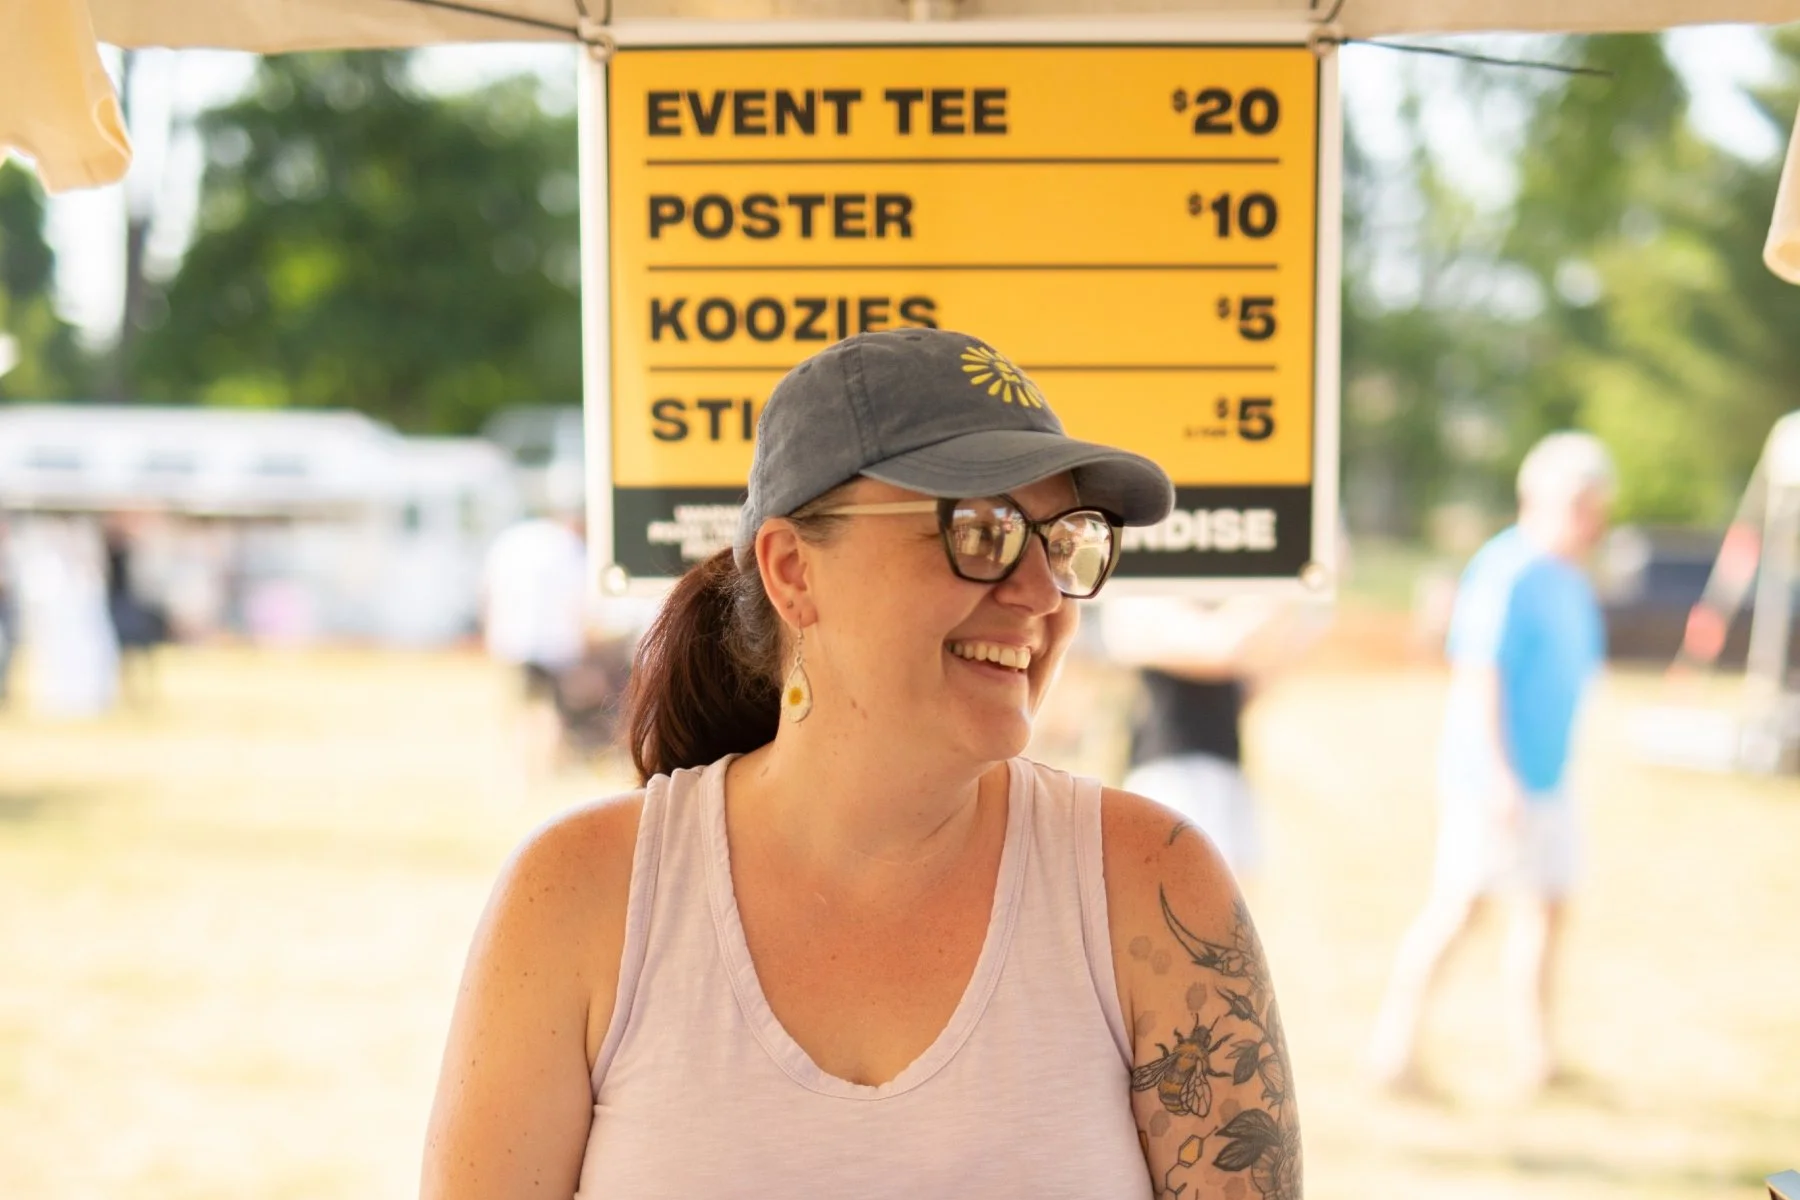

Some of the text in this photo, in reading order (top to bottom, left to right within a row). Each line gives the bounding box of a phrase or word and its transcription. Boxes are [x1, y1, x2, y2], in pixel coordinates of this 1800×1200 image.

[647, 87, 1280, 136] EVENT TEE $20
[649, 192, 1278, 240] POSTER $10
[649, 296, 1276, 342] KOOZIES $5
[1216, 396, 1275, 441] $5
